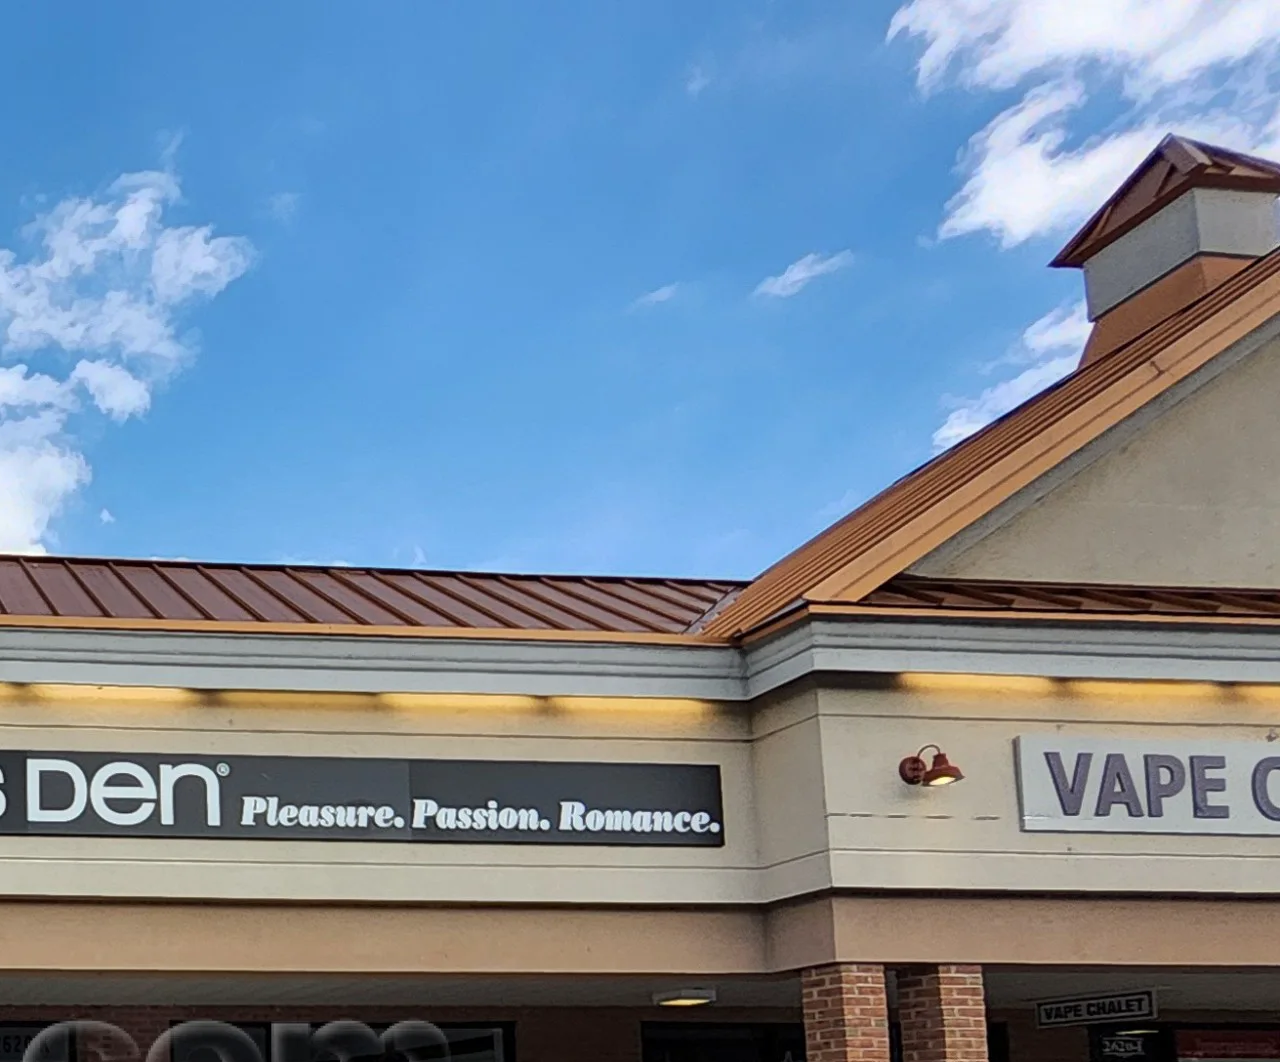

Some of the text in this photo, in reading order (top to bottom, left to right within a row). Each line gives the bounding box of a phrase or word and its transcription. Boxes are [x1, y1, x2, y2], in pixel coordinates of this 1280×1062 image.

[1044, 752, 1230, 820] VAPE
[240, 795, 720, 833] Pleasure. Passion. Romance.
[1044, 996, 1145, 1021] VAPE CHALET
